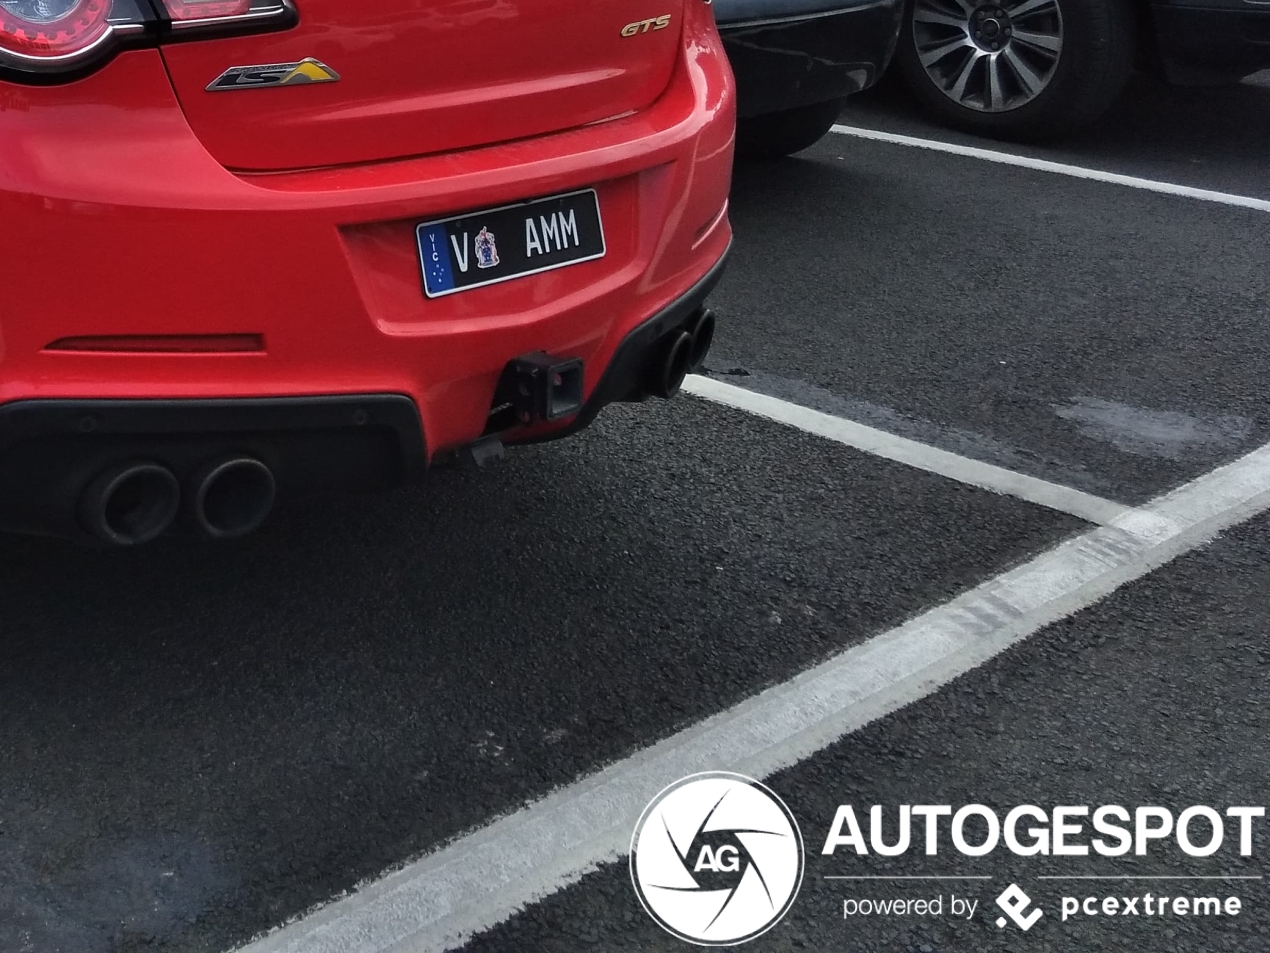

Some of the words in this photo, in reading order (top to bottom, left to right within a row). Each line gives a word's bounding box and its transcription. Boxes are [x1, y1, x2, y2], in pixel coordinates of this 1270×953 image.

[621, 14, 671, 36] GTS
[429, 234, 439, 261] VIC
[450, 232, 468, 273] V
[525, 209, 580, 258] AMM
